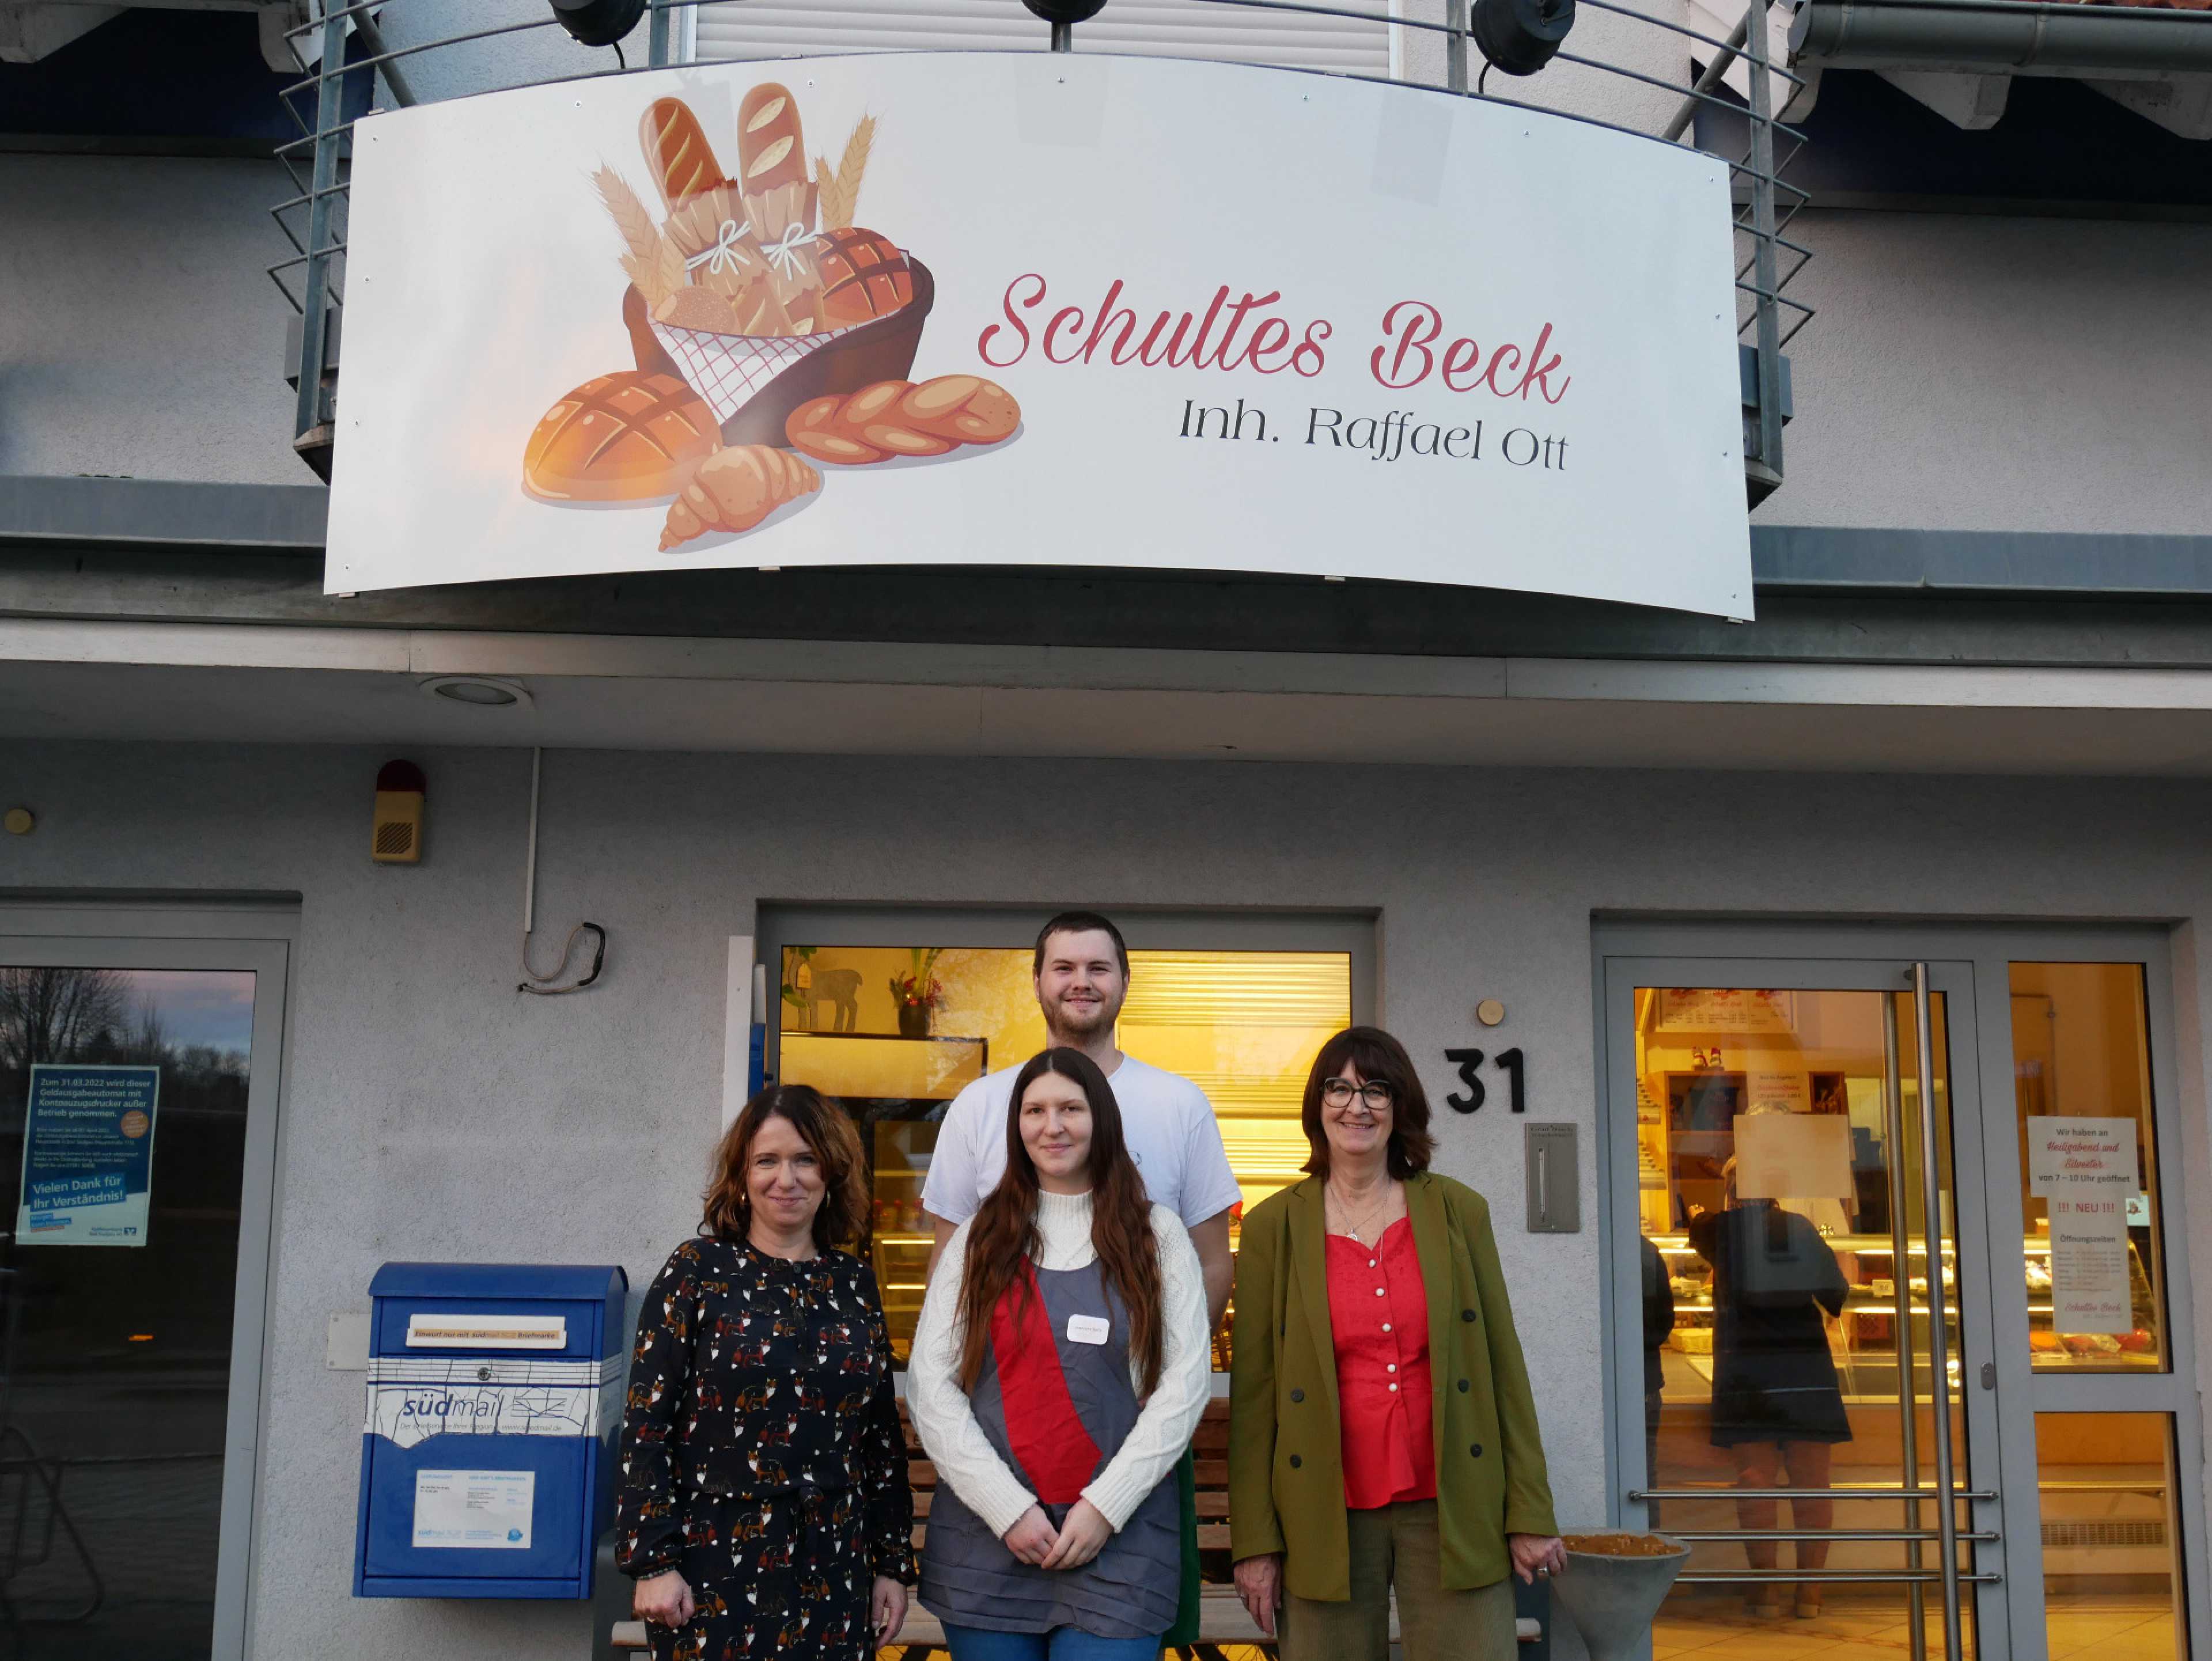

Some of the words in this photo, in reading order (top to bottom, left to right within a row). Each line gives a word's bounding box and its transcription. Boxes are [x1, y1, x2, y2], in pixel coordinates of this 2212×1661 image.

[978, 274, 1333, 377] Schultes
[1370, 300, 1571, 404] Beck
[1179, 398, 1279, 443] Inh.
[1305, 407, 1483, 461] Raffael
[1502, 428, 1570, 471] Ott
[40, 1078, 59, 1086] Zum
[107, 1079, 125, 1087] wird
[126, 1080, 151, 1088] dieser
[1445, 1048, 1525, 1114] 31
[127, 1090, 142, 1098] mit
[123, 1099, 147, 1108] außer
[37, 1109, 67, 1117] Betrieb
[69, 1110, 117, 1119] genommen.
[2073, 1128, 2096, 1136] haben
[2097, 1174, 2130, 1184] geöffnet
[33, 1182, 69, 1194] Vielen
[72, 1177, 101, 1190] Dank
[104, 1175, 122, 1187] für
[33, 1199, 50, 1209] Ihr
[52, 1189, 123, 1207] Verständnis!
[2076, 1202, 2099, 1212] NEU
[2060, 1233, 2116, 1244] Öffnungszeiten
[517, 1331, 556, 1339] Briefmarke
[403, 1393, 505, 1417] südmail
